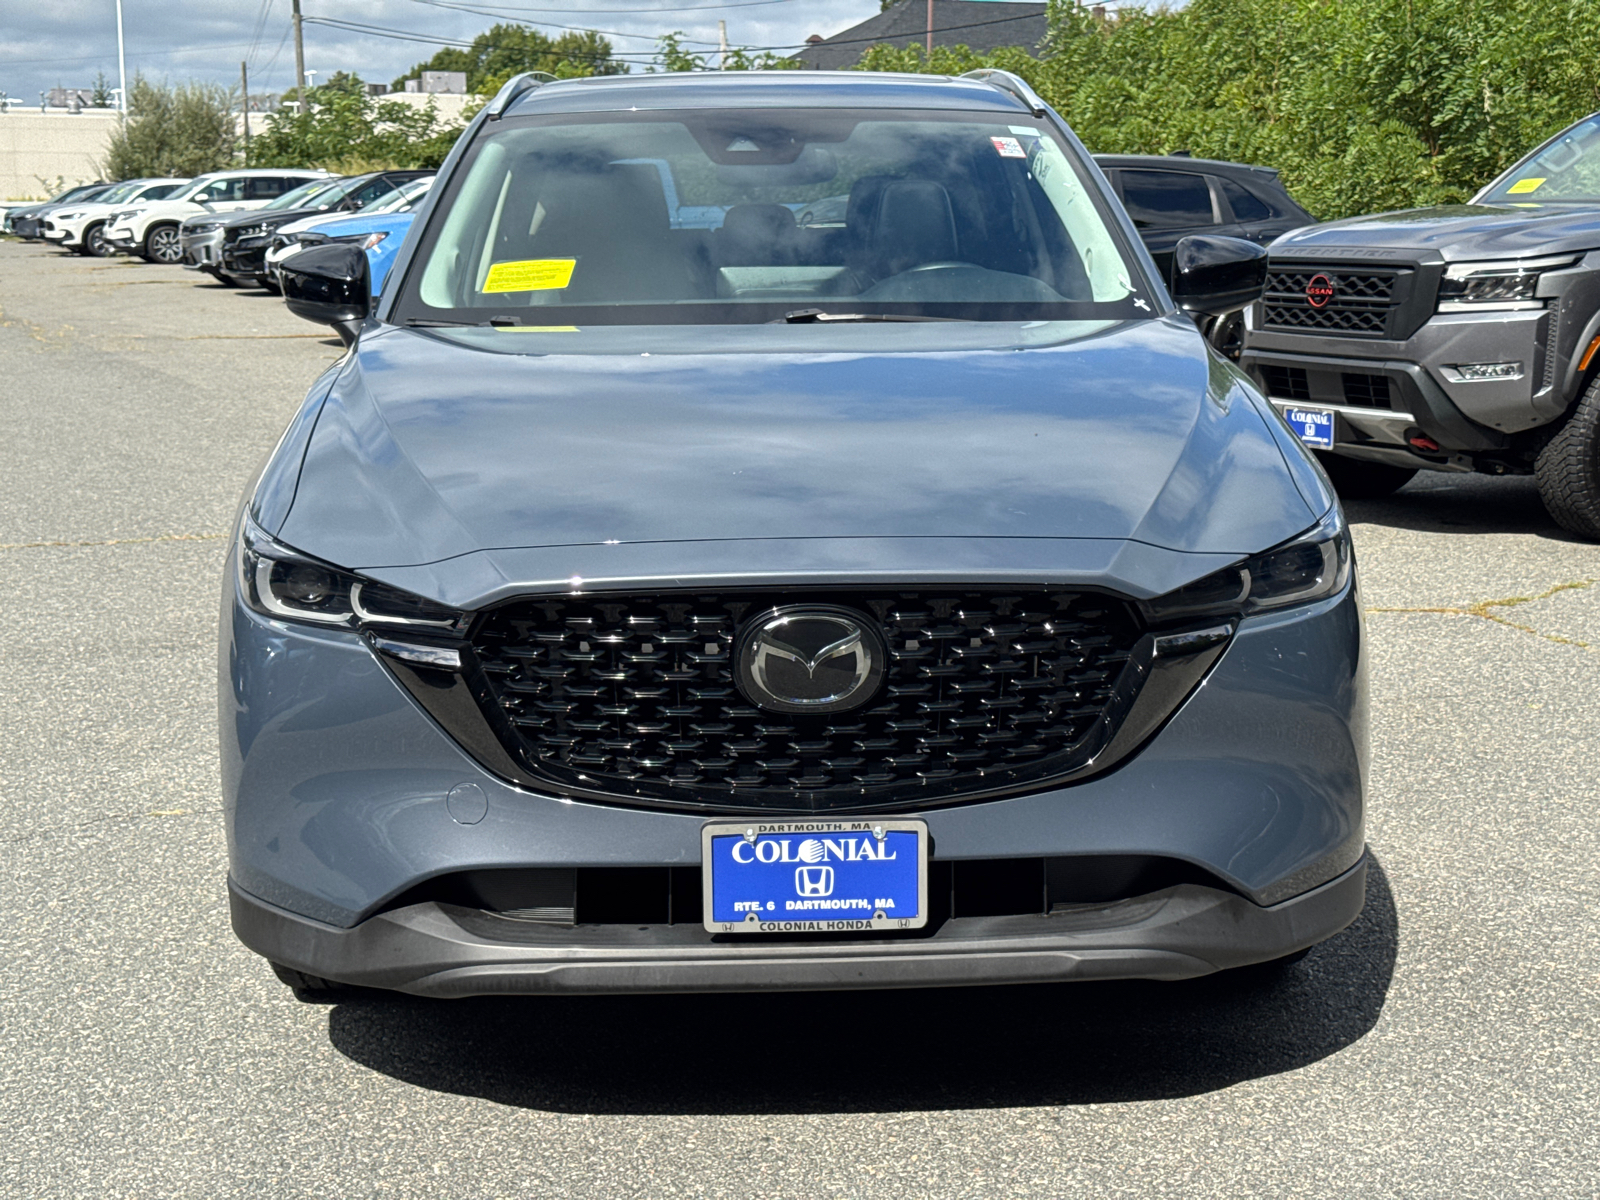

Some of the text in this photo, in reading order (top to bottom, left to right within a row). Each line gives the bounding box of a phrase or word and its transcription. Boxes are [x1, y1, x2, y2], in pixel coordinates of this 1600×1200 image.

[1280, 247, 1397, 258] FRONTIER
[1291, 411, 1330, 425] COLONIAL
[758, 822, 871, 833] DARTMOUTH, MA
[731, 838, 897, 863] COLONIAL
[734, 898, 896, 911] RTE. 6 DARTMOUTH, MA
[759, 920, 873, 932] COLONIAL HONDA
